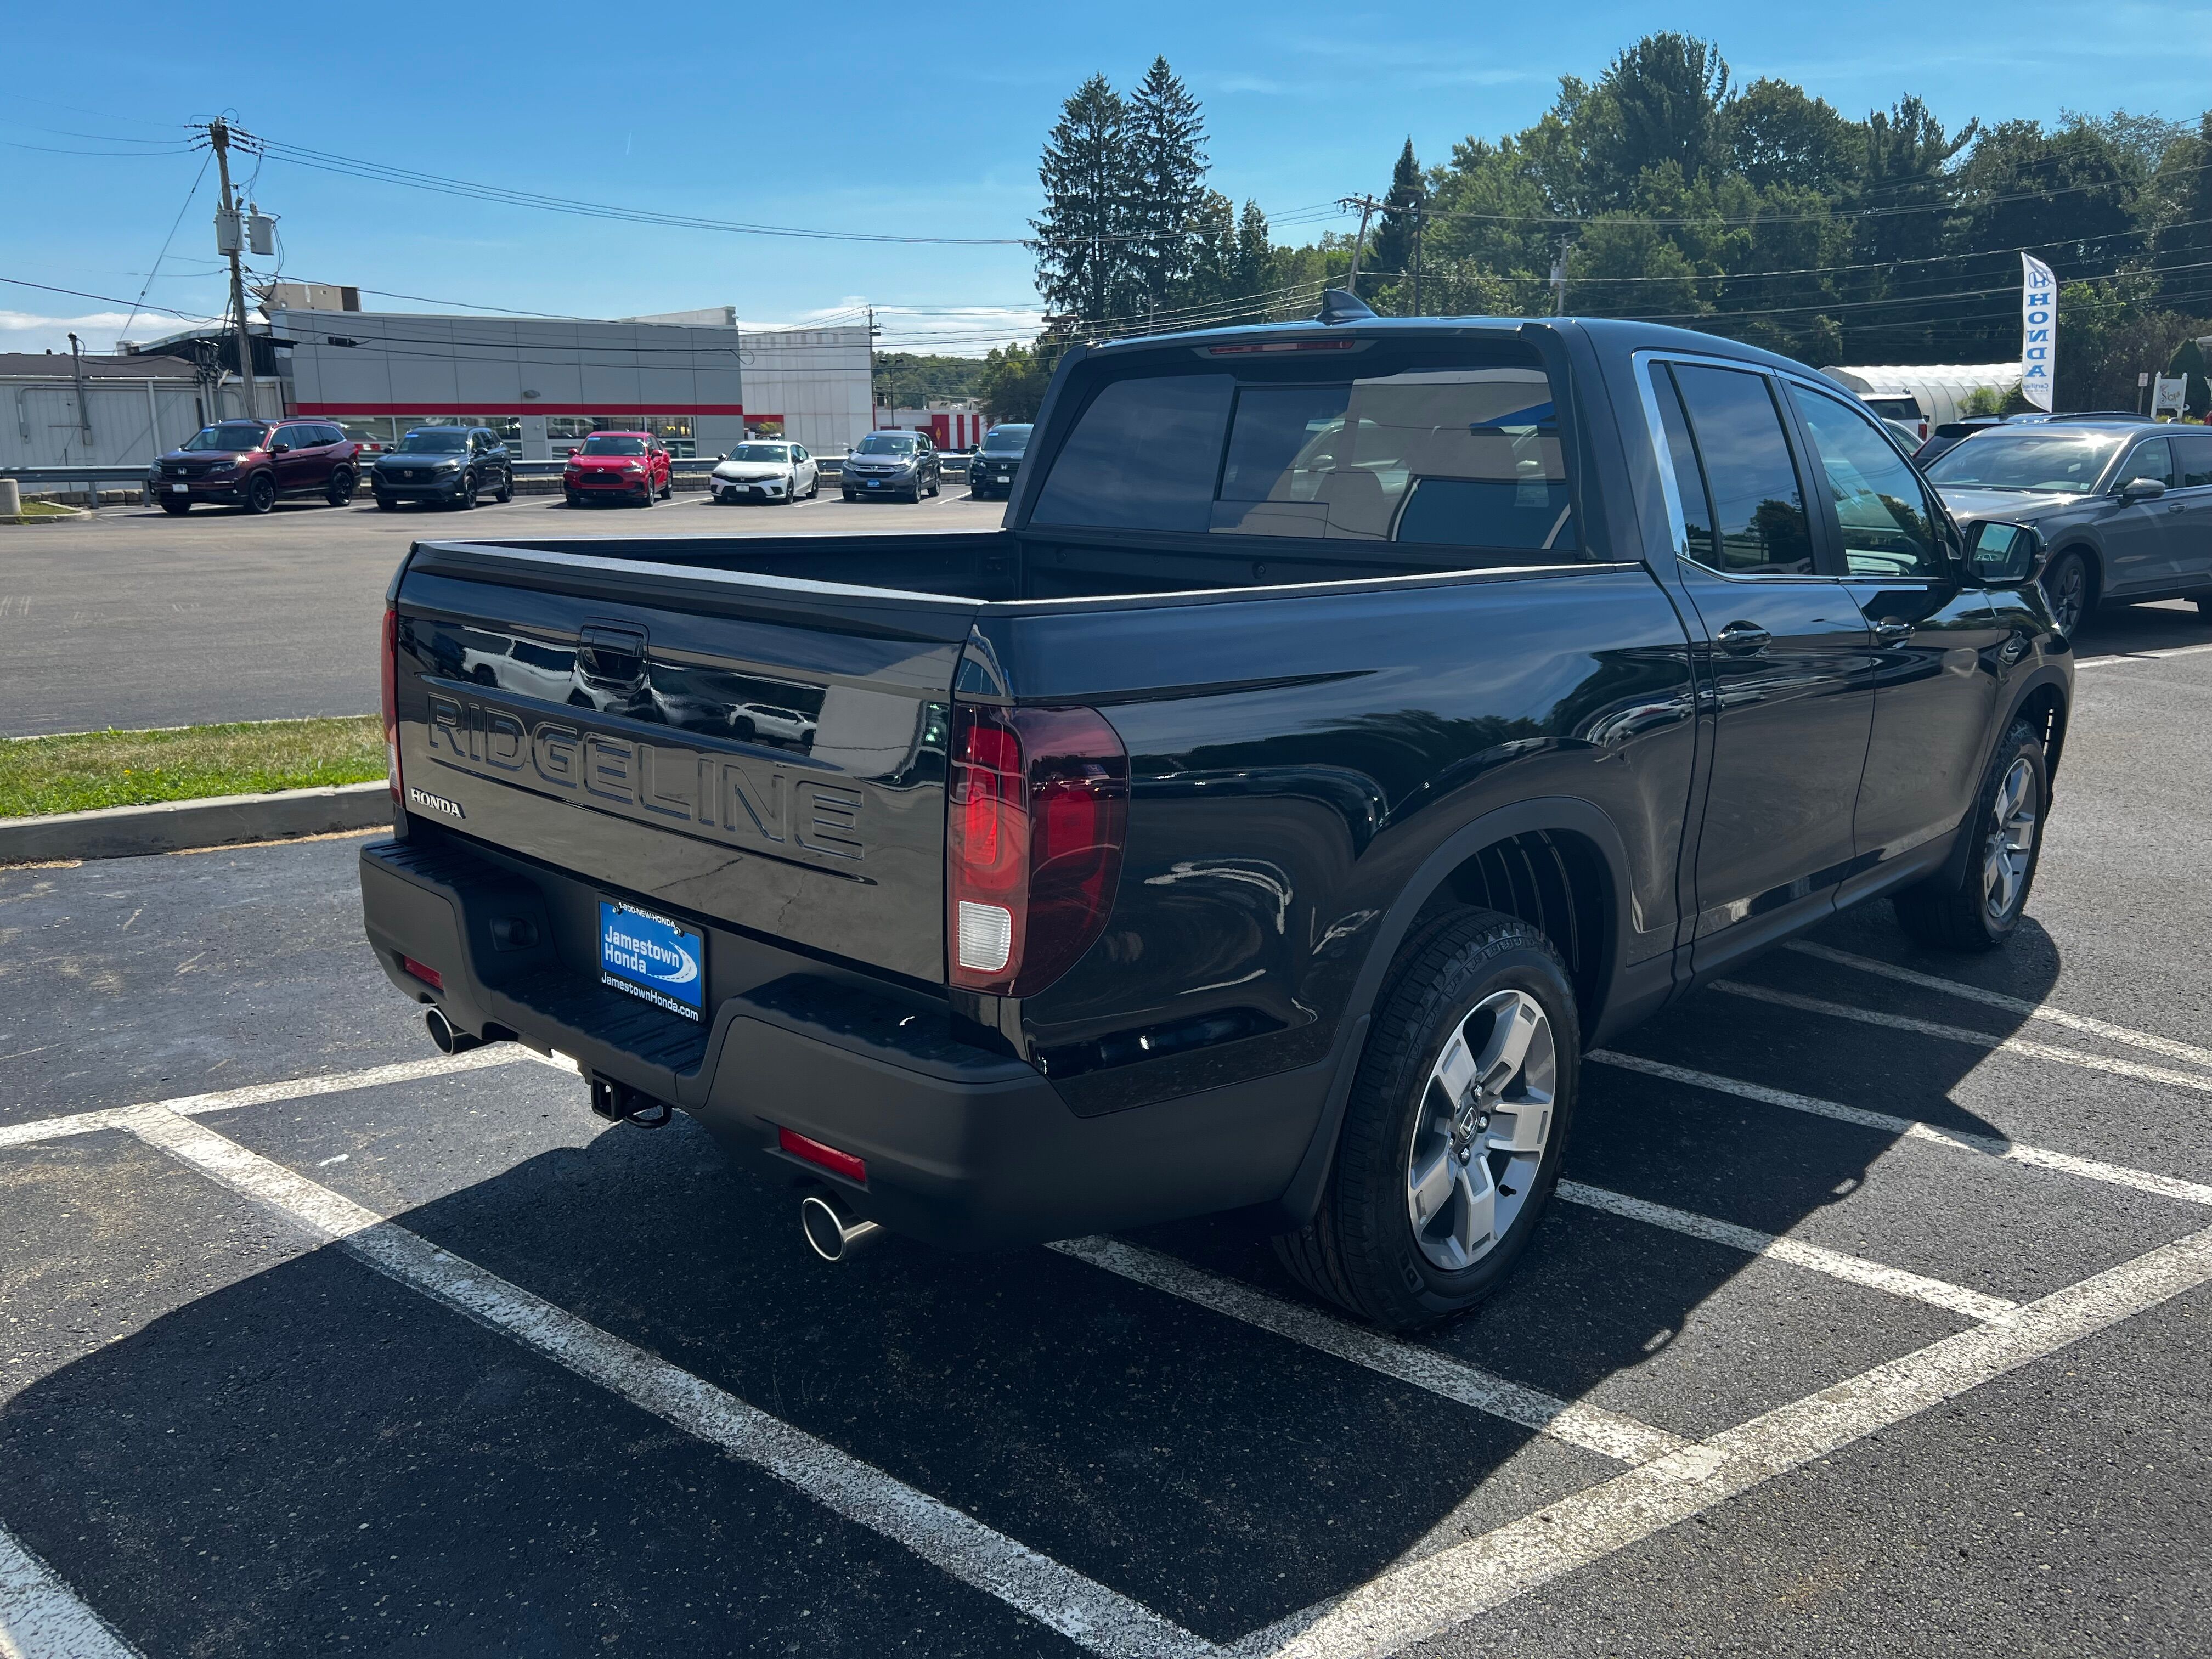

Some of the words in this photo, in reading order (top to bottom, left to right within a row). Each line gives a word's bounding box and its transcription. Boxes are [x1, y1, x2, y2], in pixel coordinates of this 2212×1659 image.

[428, 691, 865, 861] RIDGELINE
[410, 788, 465, 819] HONDA
[618, 901, 676, 928] 1-800-NEW-HONDA
[605, 926, 679, 968] Jamestown
[605, 942, 646, 974] Honda
[601, 972, 698, 1022] JamestownHonda.com
